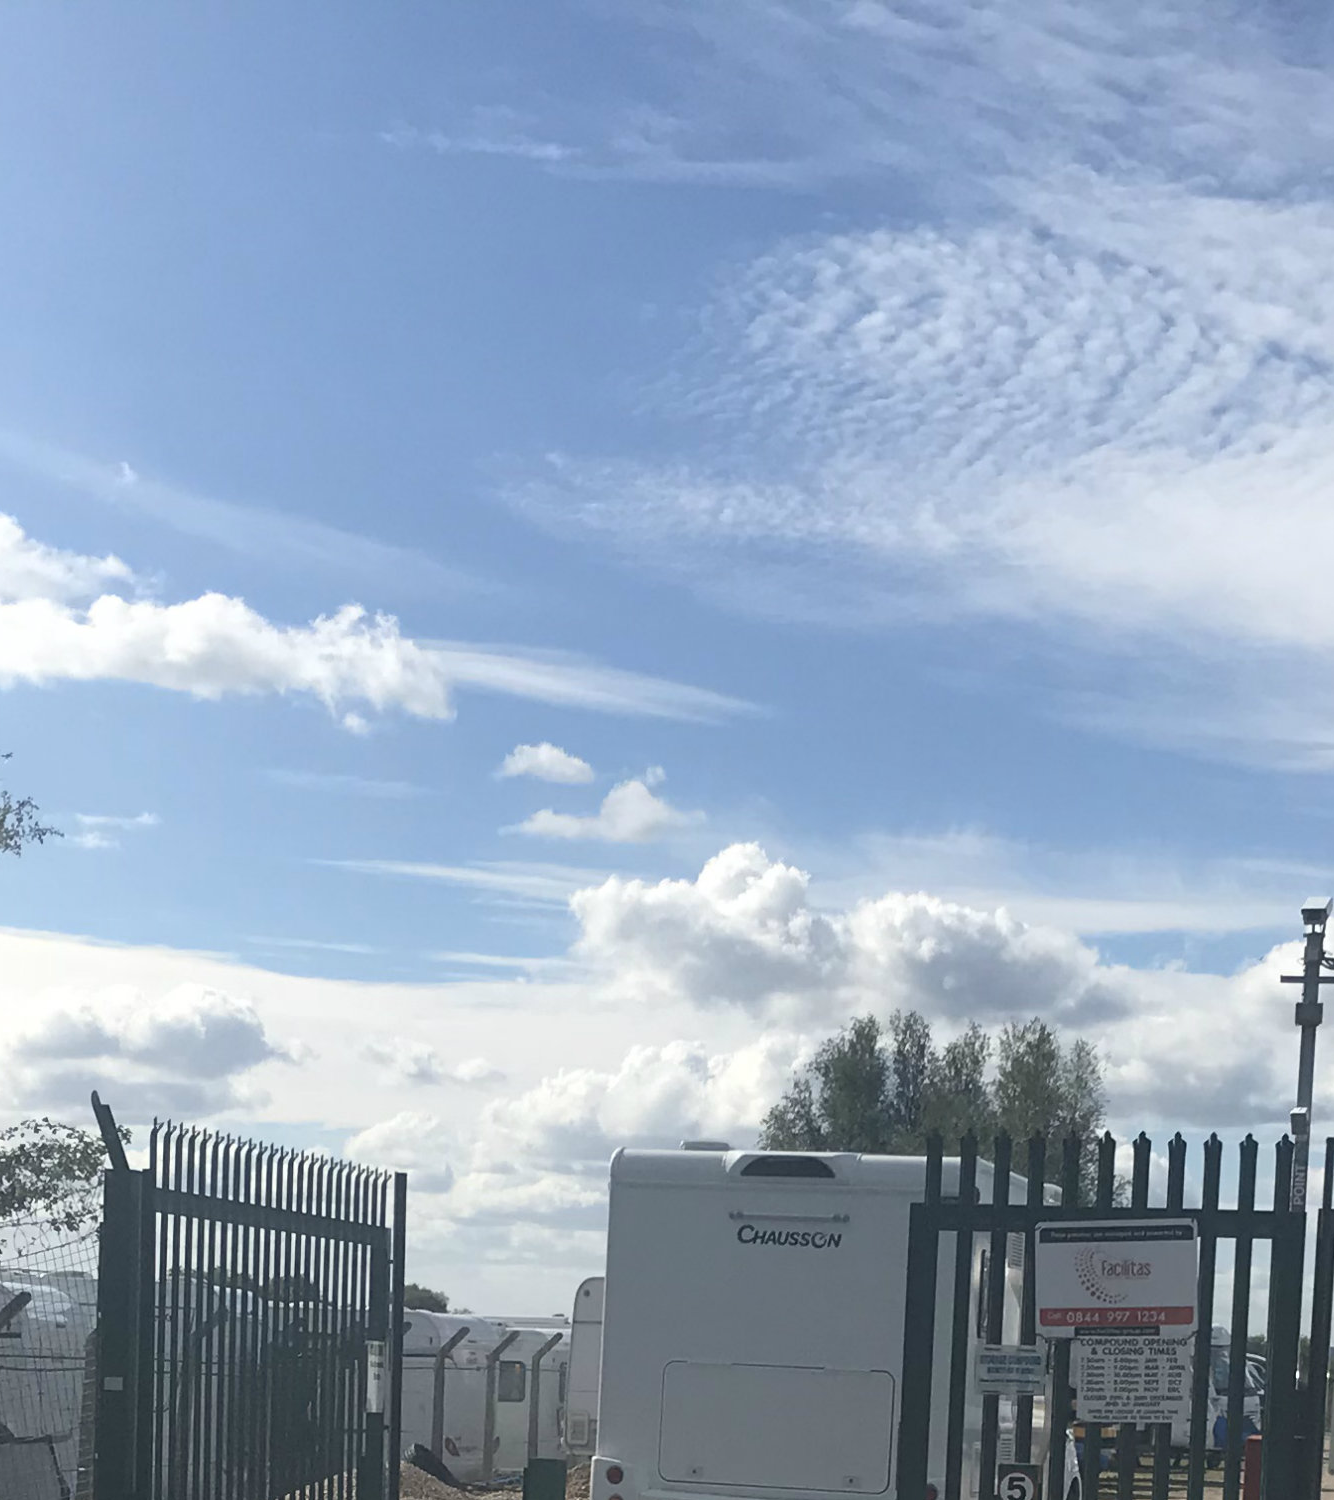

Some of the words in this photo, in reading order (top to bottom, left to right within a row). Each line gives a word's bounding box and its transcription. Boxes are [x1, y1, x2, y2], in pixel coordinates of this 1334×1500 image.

[1293, 1163, 1306, 1206] POINT
[737, 1224, 843, 1249] CHAUSSON
[1066, 1311, 1100, 1323] 0844
[1107, 1311, 1130, 1322] 997
[1137, 1311, 1166, 1322] 1234
[1080, 1338, 1139, 1347] COMPOUND
[1142, 1338, 1187, 1347] OPENING
[1090, 1347, 1098, 1355] &
[1102, 1347, 1144, 1355] CLOSING
[1148, 1347, 1177, 1355] TIMES
